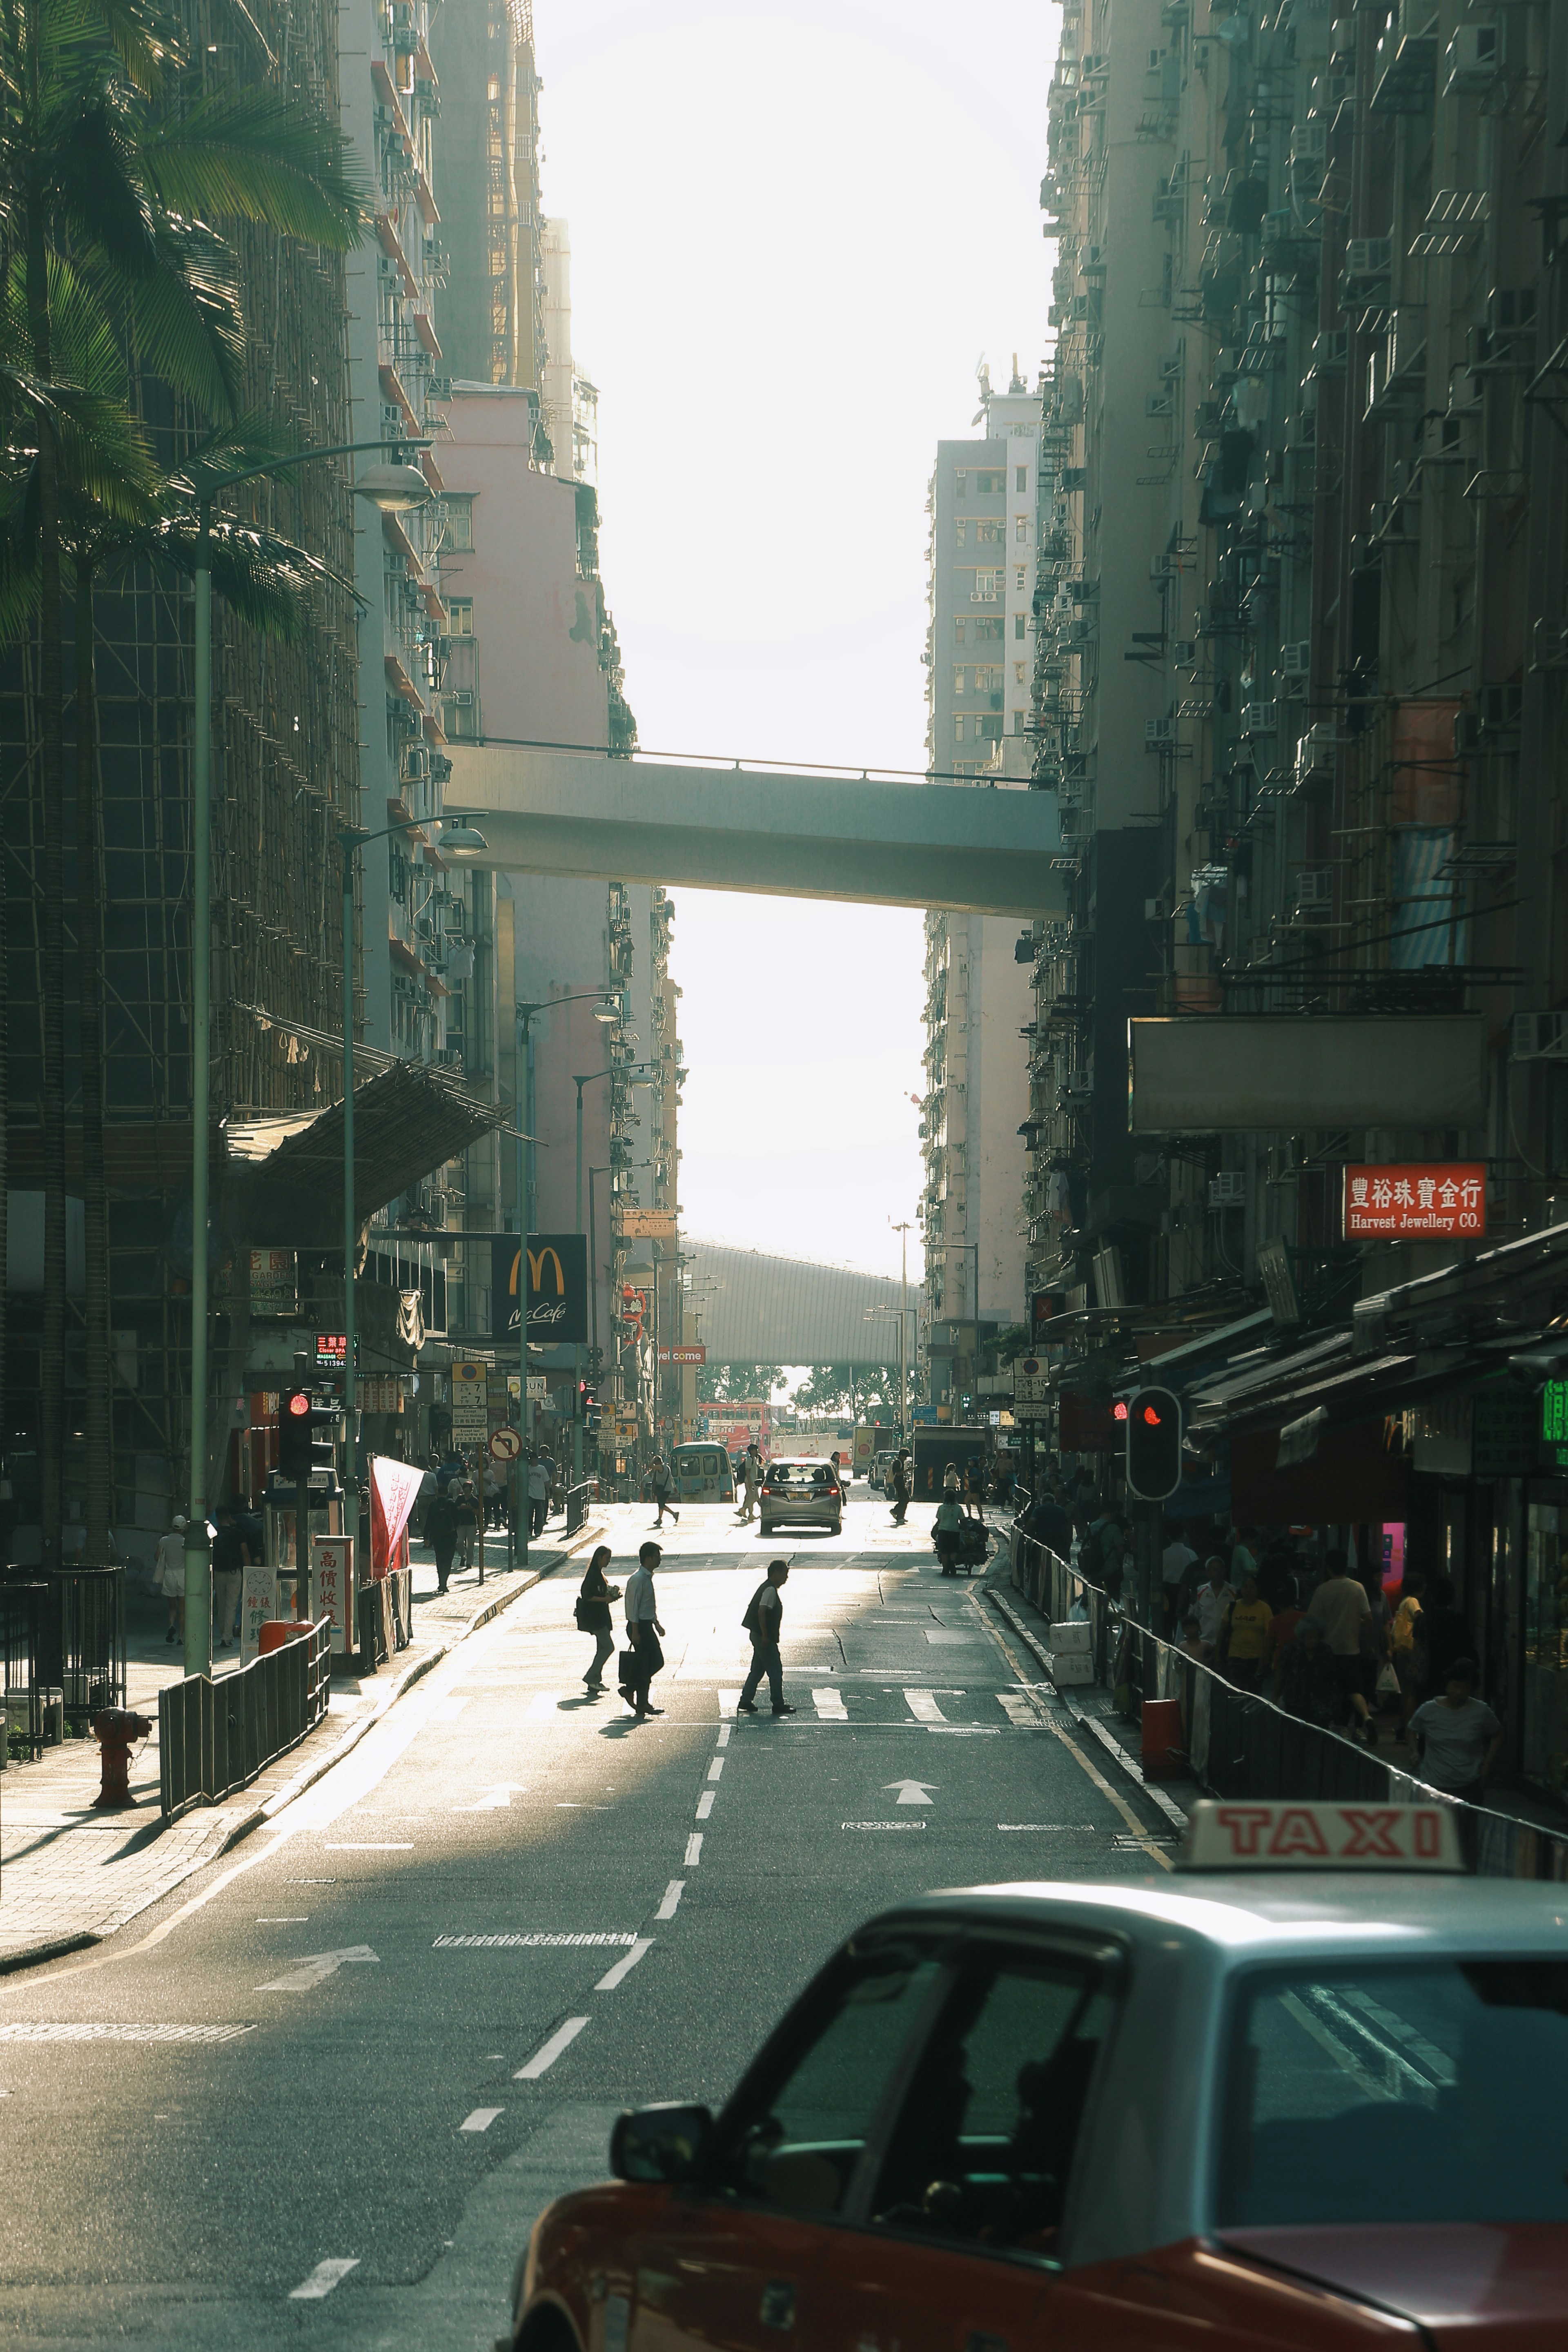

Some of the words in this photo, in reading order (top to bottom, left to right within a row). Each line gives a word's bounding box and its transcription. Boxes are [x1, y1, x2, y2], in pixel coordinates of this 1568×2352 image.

[1350, 1177, 1482, 1209] 豐裕珠寶金行
[1351, 1214, 1396, 1228] Harvest
[1400, 1213, 1455, 1231] Jewellery
[1459, 1213, 1481, 1227] CO.
[508, 1303, 566, 1324] McCafé
[318, 1336, 347, 1347] 三葉草
[474, 1383, 480, 1392] 7
[247, 1596, 272, 1608] 鐘錶
[1216, 1807, 1443, 1858] TAXI
